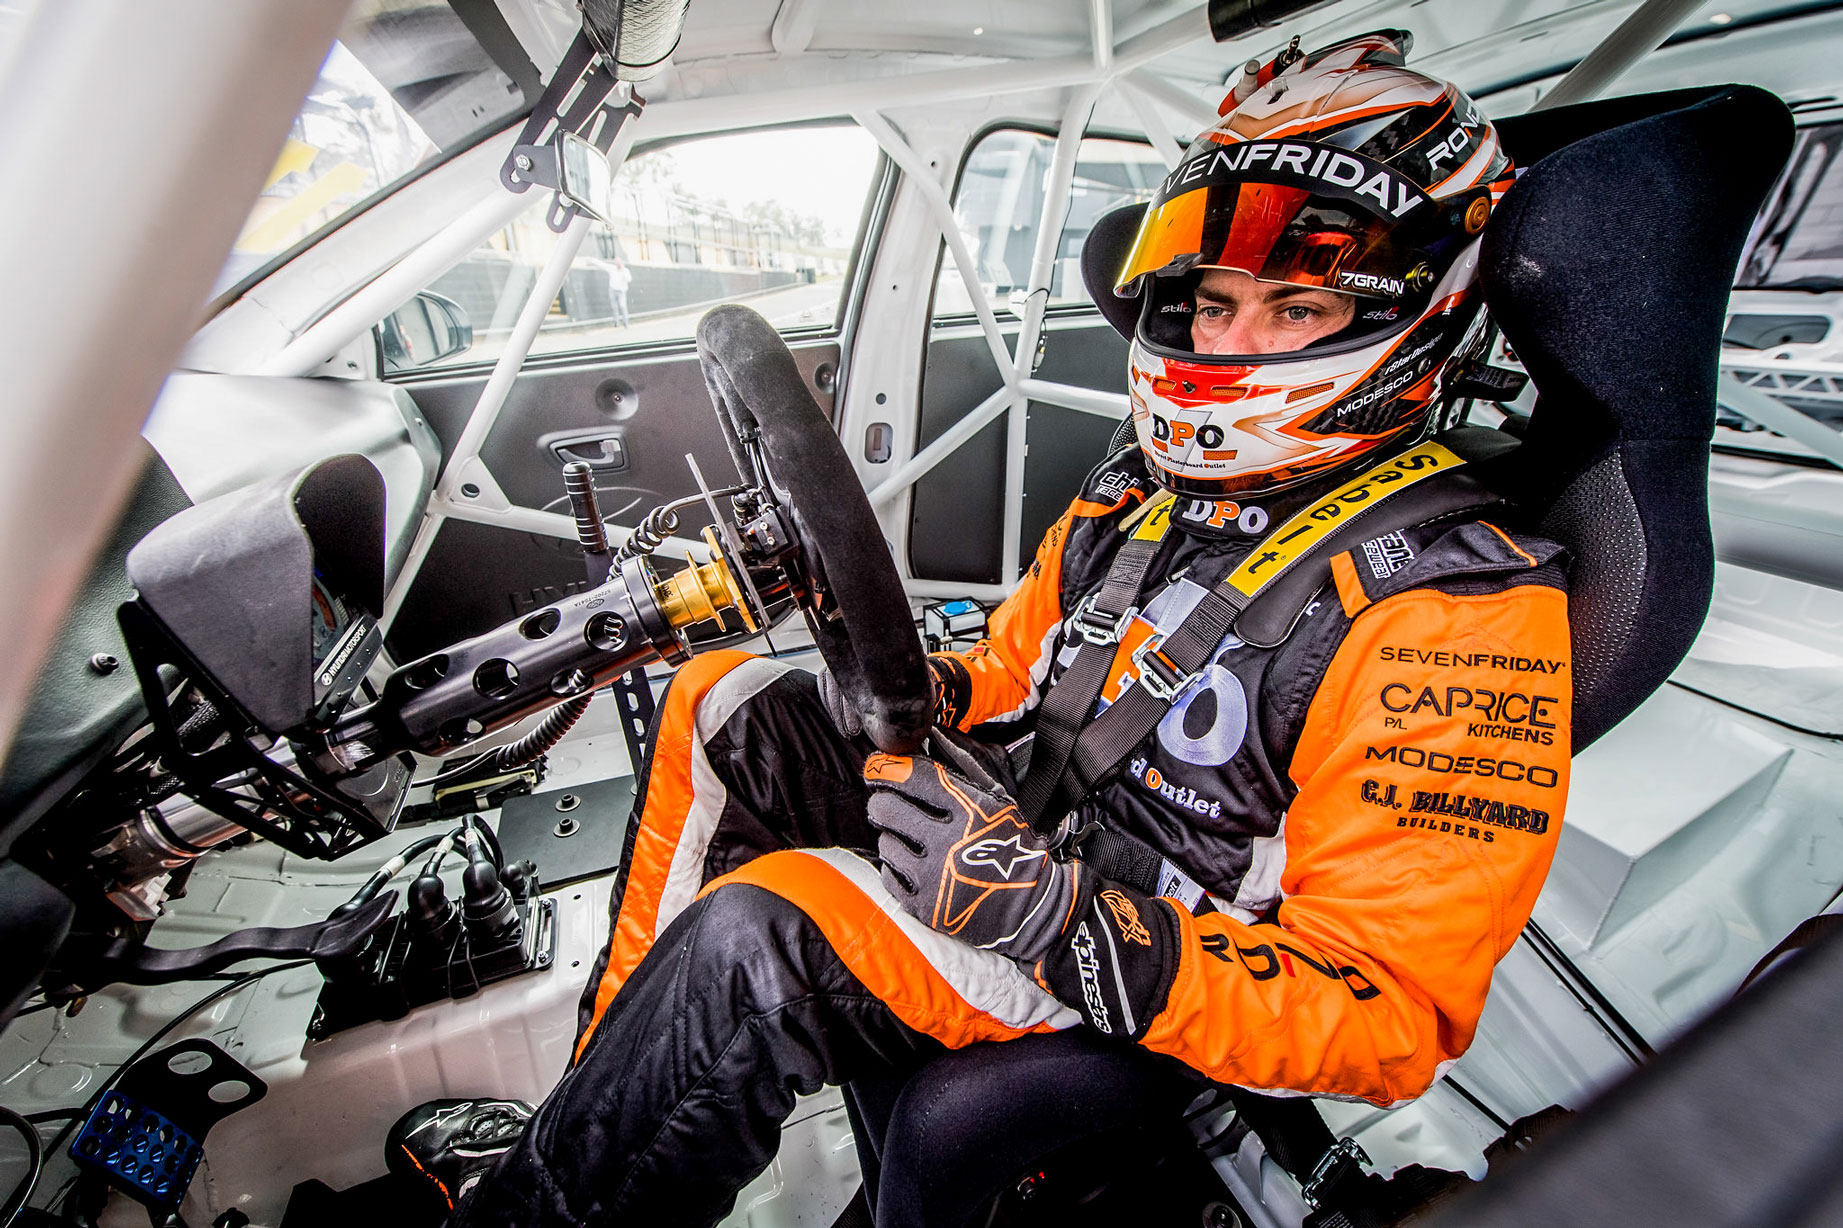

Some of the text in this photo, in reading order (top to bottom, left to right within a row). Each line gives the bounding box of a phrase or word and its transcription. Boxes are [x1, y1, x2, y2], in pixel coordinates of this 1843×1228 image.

[1165, 143, 1423, 218] VENFRIDAY
[1340, 271, 1405, 295] 7GRAIN
[1160, 302, 1192, 313] stilo
[1362, 306, 1399, 321] stilo
[1337, 370, 1414, 417] MODESCO
[1152, 412, 1225, 449] DPO
[1182, 499, 1269, 534] DPO
[1248, 454, 1439, 574] Sabelt
[344, 625, 367, 656] MOTORSPORT
[1380, 647, 1563, 675] SEVENFRIDAY
[1380, 683, 1559, 729] CAPRICE
[1467, 723, 1554, 746] KITCHENS
[1365, 746, 1559, 789] MODESCO
[1145, 767, 1221, 819] Outlet
[1397, 816, 1495, 843] BUILDERS
[1409, 790, 1550, 835] BILLYARD
